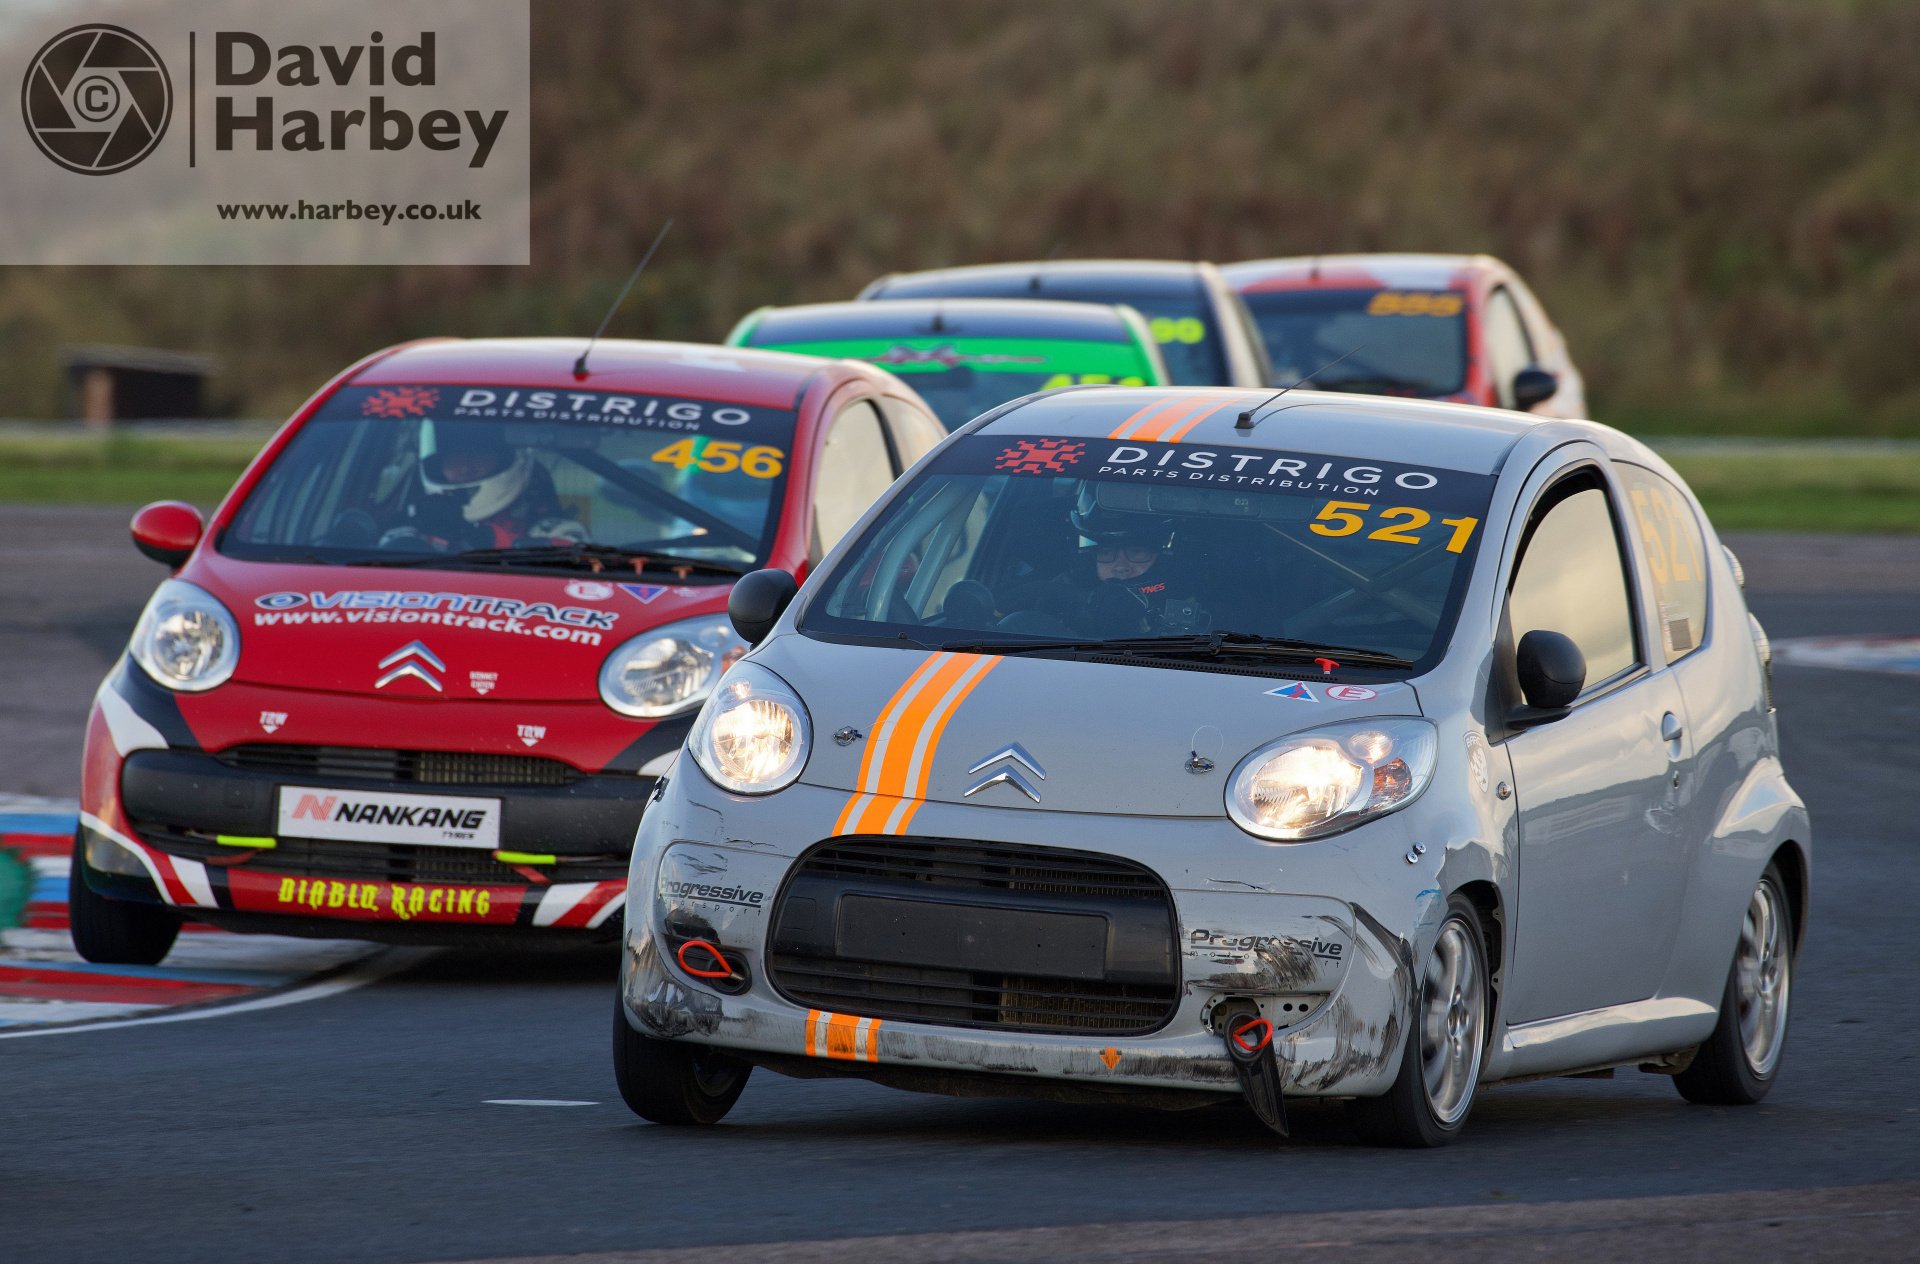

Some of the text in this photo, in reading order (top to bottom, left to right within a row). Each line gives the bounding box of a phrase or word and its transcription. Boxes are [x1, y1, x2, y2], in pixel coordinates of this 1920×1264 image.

[454, 406, 700, 432] PARTS DISTRIBUTION
[460, 390, 751, 425] DISTRIGO
[651, 437, 784, 478] 456
[1107, 446, 1438, 490] DISTRIGO
[1098, 465, 1380, 497] PARTS DISTRIBUTION
[1309, 499, 1480, 554] 521
[1138, 582, 1166, 594] YNES
[254, 609, 602, 647] www.visiontrack.com
[334, 803, 487, 830] NANKANG
[389, 883, 491, 920] RACING
